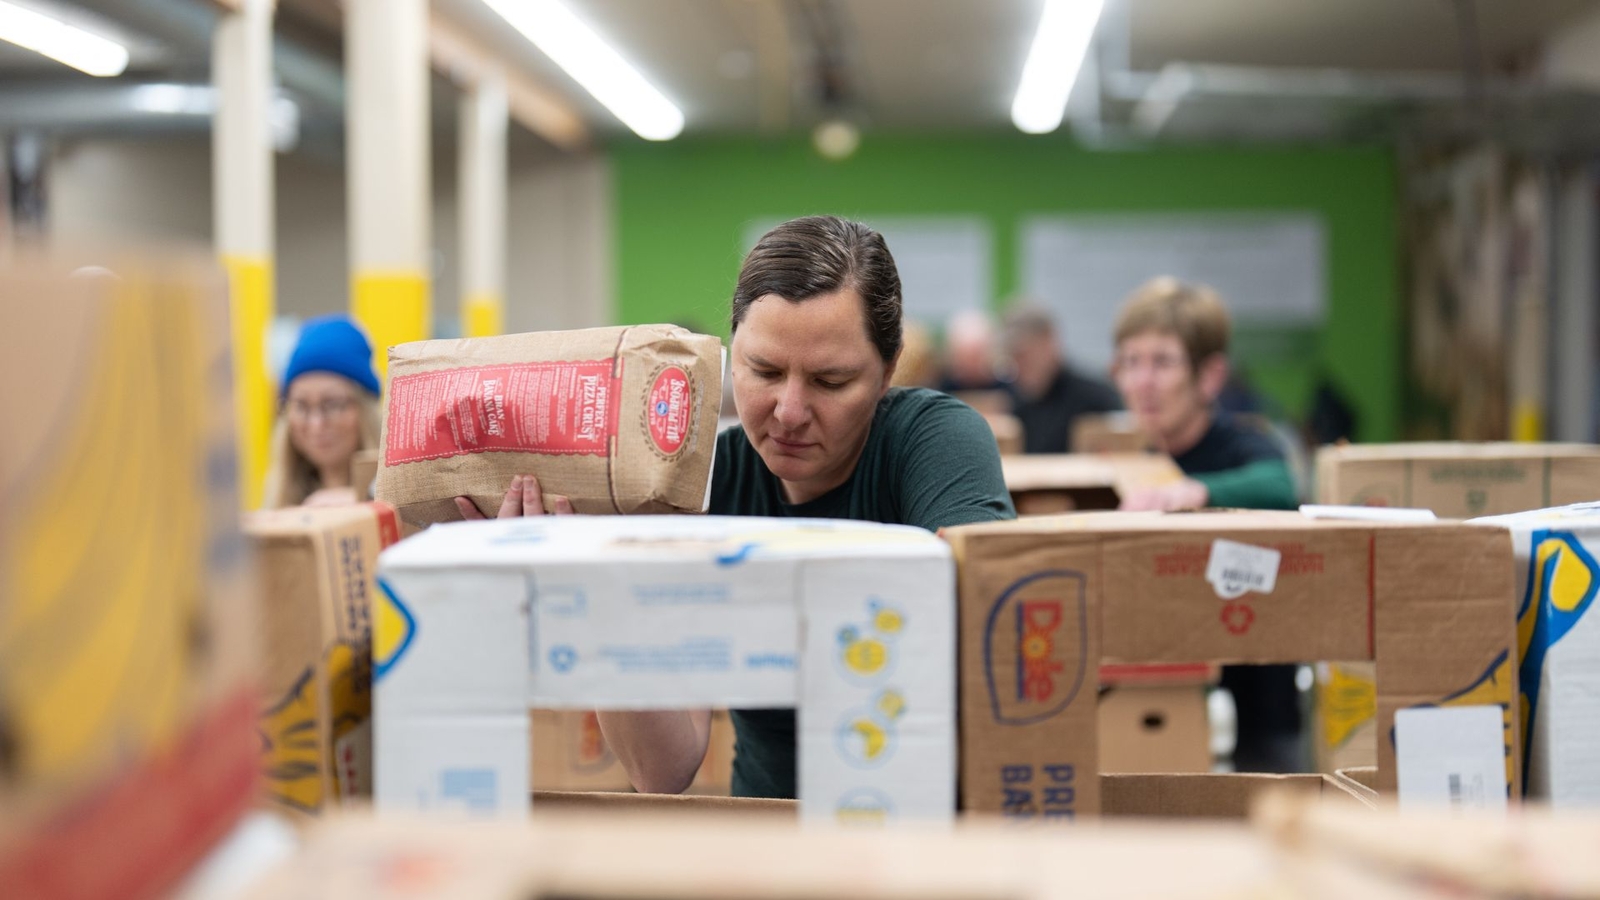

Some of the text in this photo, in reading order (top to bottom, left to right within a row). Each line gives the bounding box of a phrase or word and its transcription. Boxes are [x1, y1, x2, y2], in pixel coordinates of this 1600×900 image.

[483, 379, 500, 436] BANANA CAKE
[494, 395, 505, 420] BRAN
[580, 375, 598, 405] PIZZA
[595, 386, 606, 428] PERFECT
[666, 378, 686, 443] ALL PURPOSE
[577, 406, 595, 441] CRUST
[1022, 599, 1064, 704] Dole
